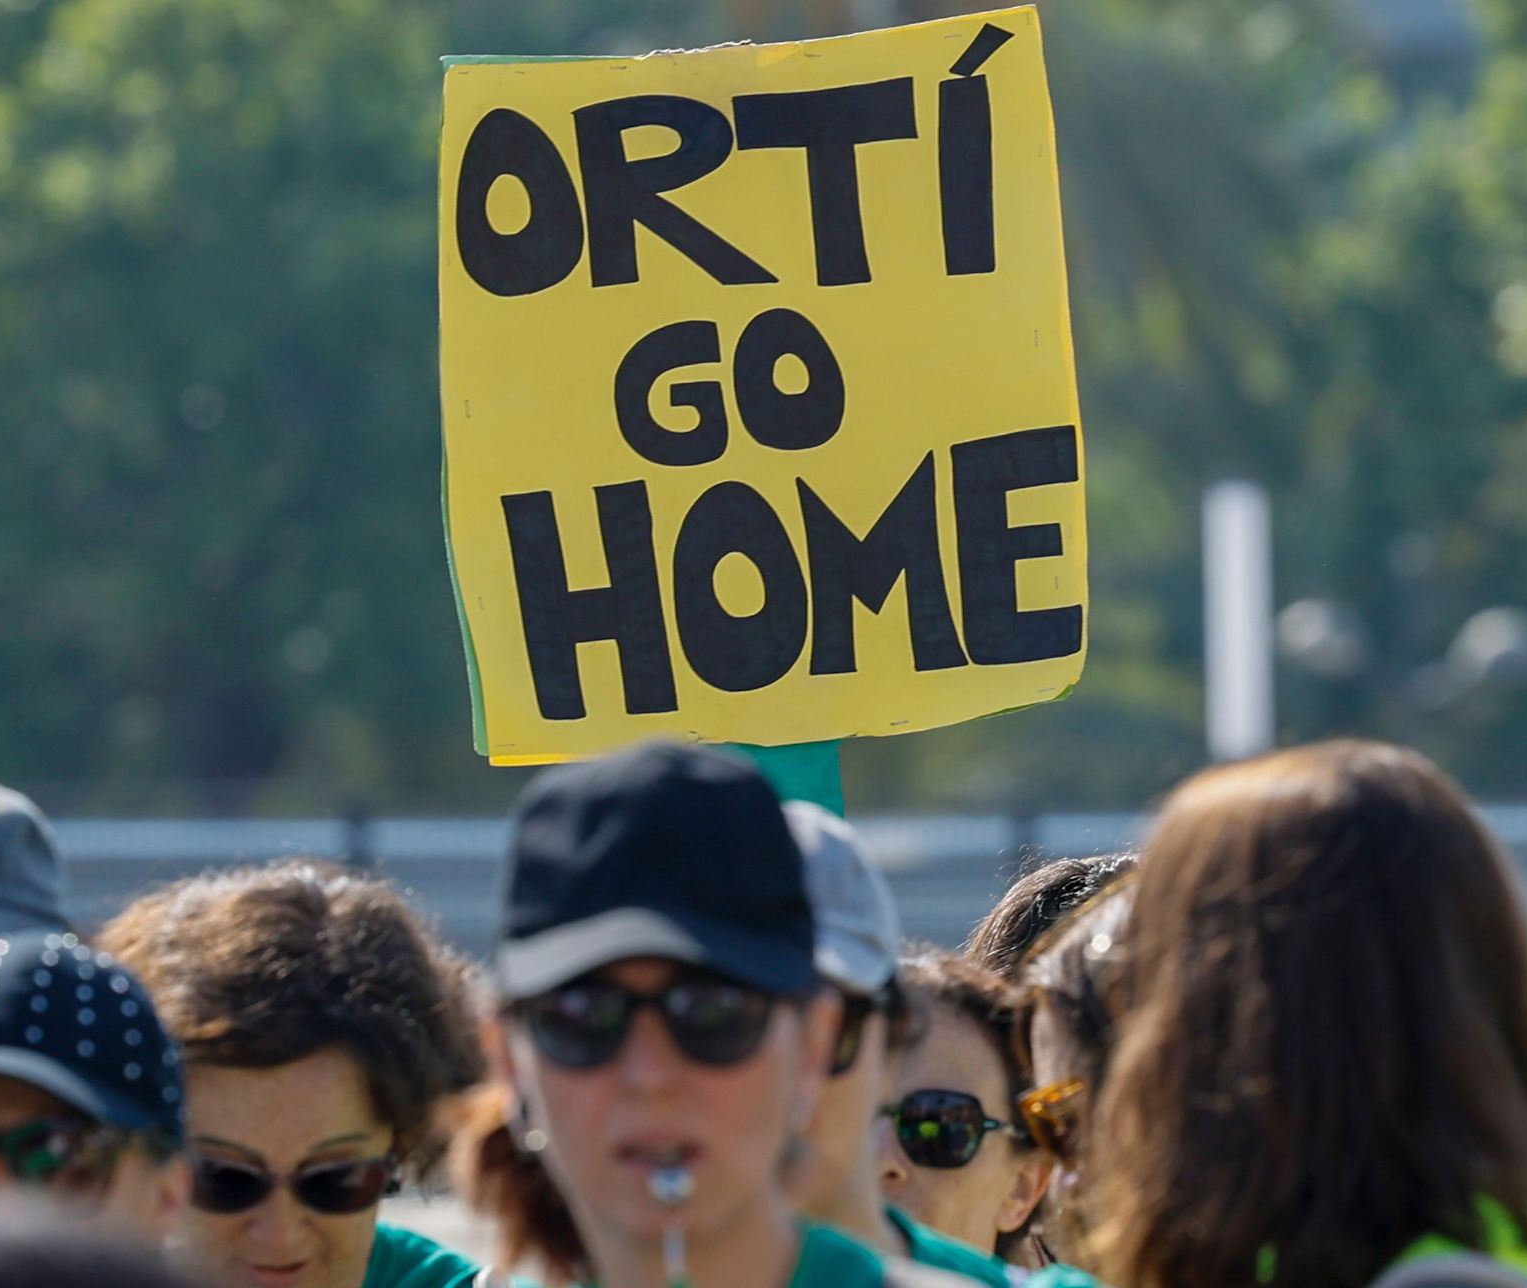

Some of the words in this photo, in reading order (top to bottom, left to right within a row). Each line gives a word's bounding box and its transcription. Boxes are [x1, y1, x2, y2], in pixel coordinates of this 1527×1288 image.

[456, 22, 1015, 298] ORTÍ
[614, 307, 846, 467] GO
[500, 424, 1083, 721] HOME
